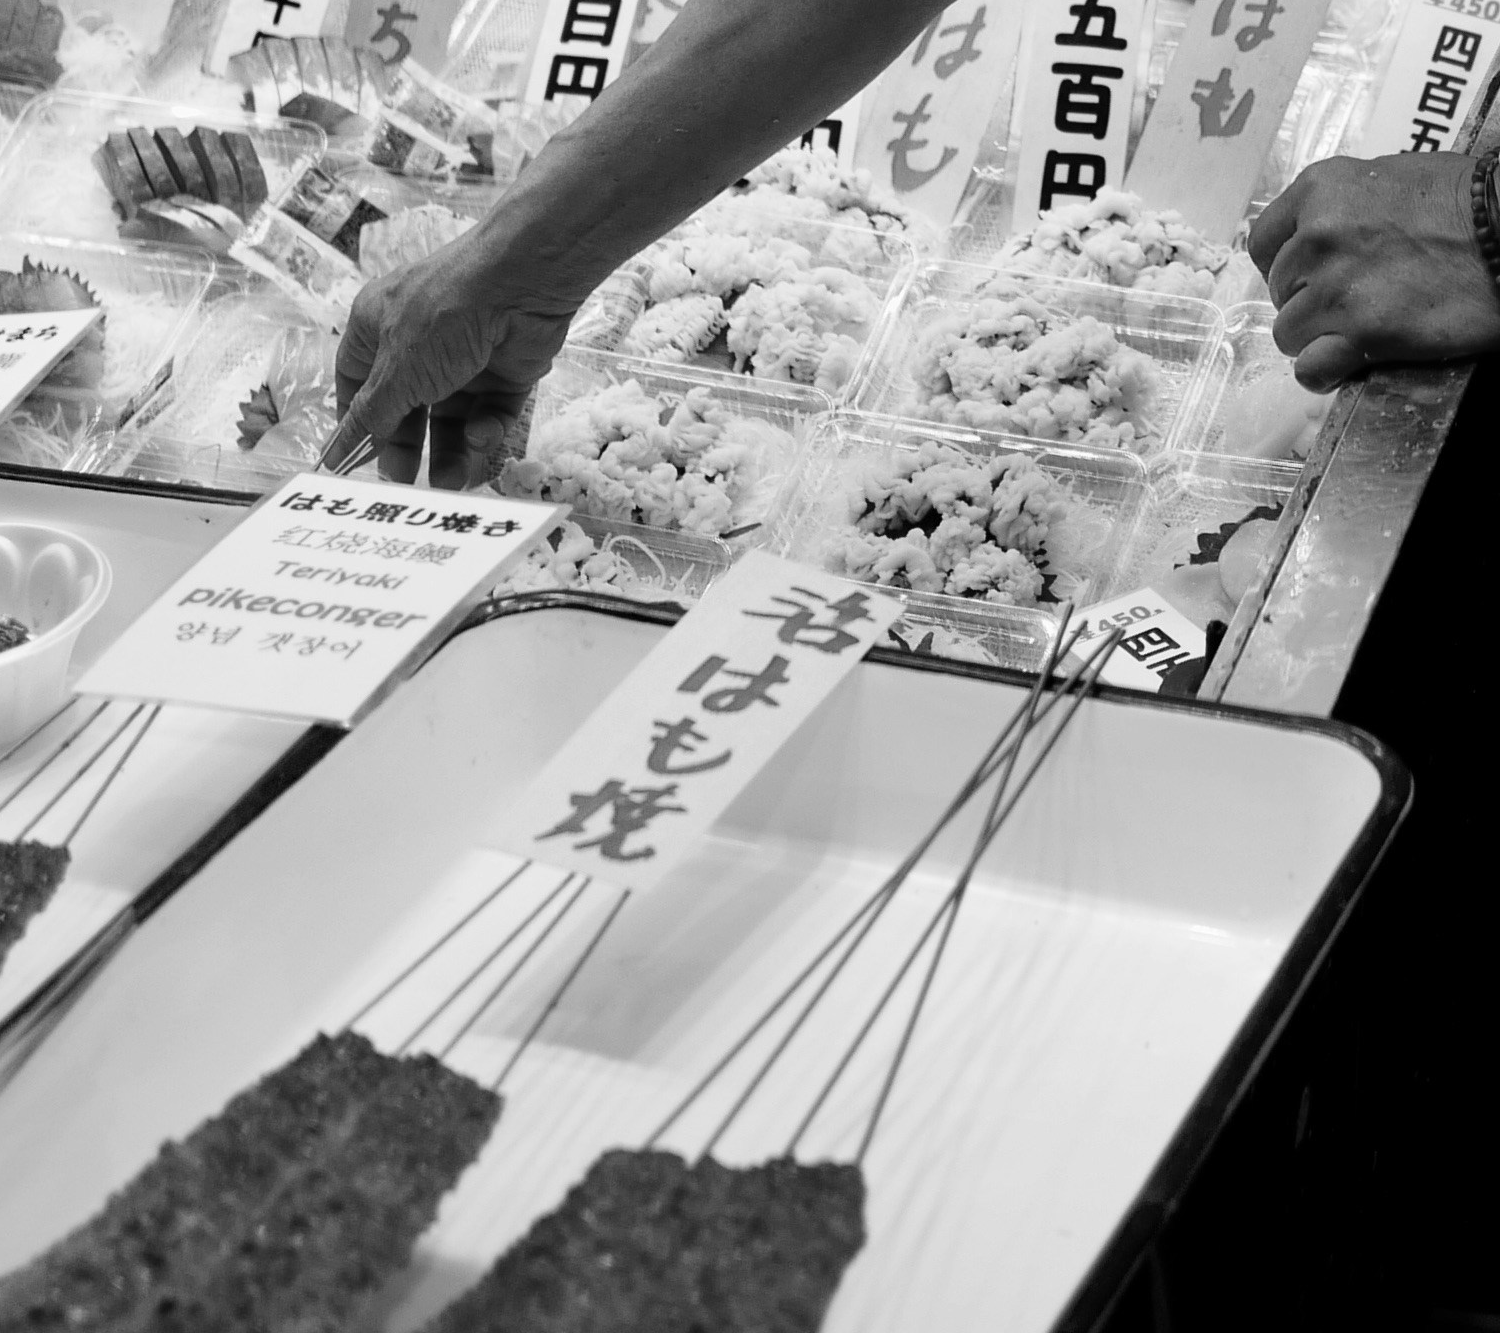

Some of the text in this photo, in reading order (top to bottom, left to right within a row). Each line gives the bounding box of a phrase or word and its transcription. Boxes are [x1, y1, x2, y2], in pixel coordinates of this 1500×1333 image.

[279, 490, 523, 538] はも照り焼き
[273, 559, 410, 591] Teriyaki
[178, 586, 429, 631] pikeconger
[176, 621, 243, 646] 양념
[533, 584, 877, 866] 活はも焼
